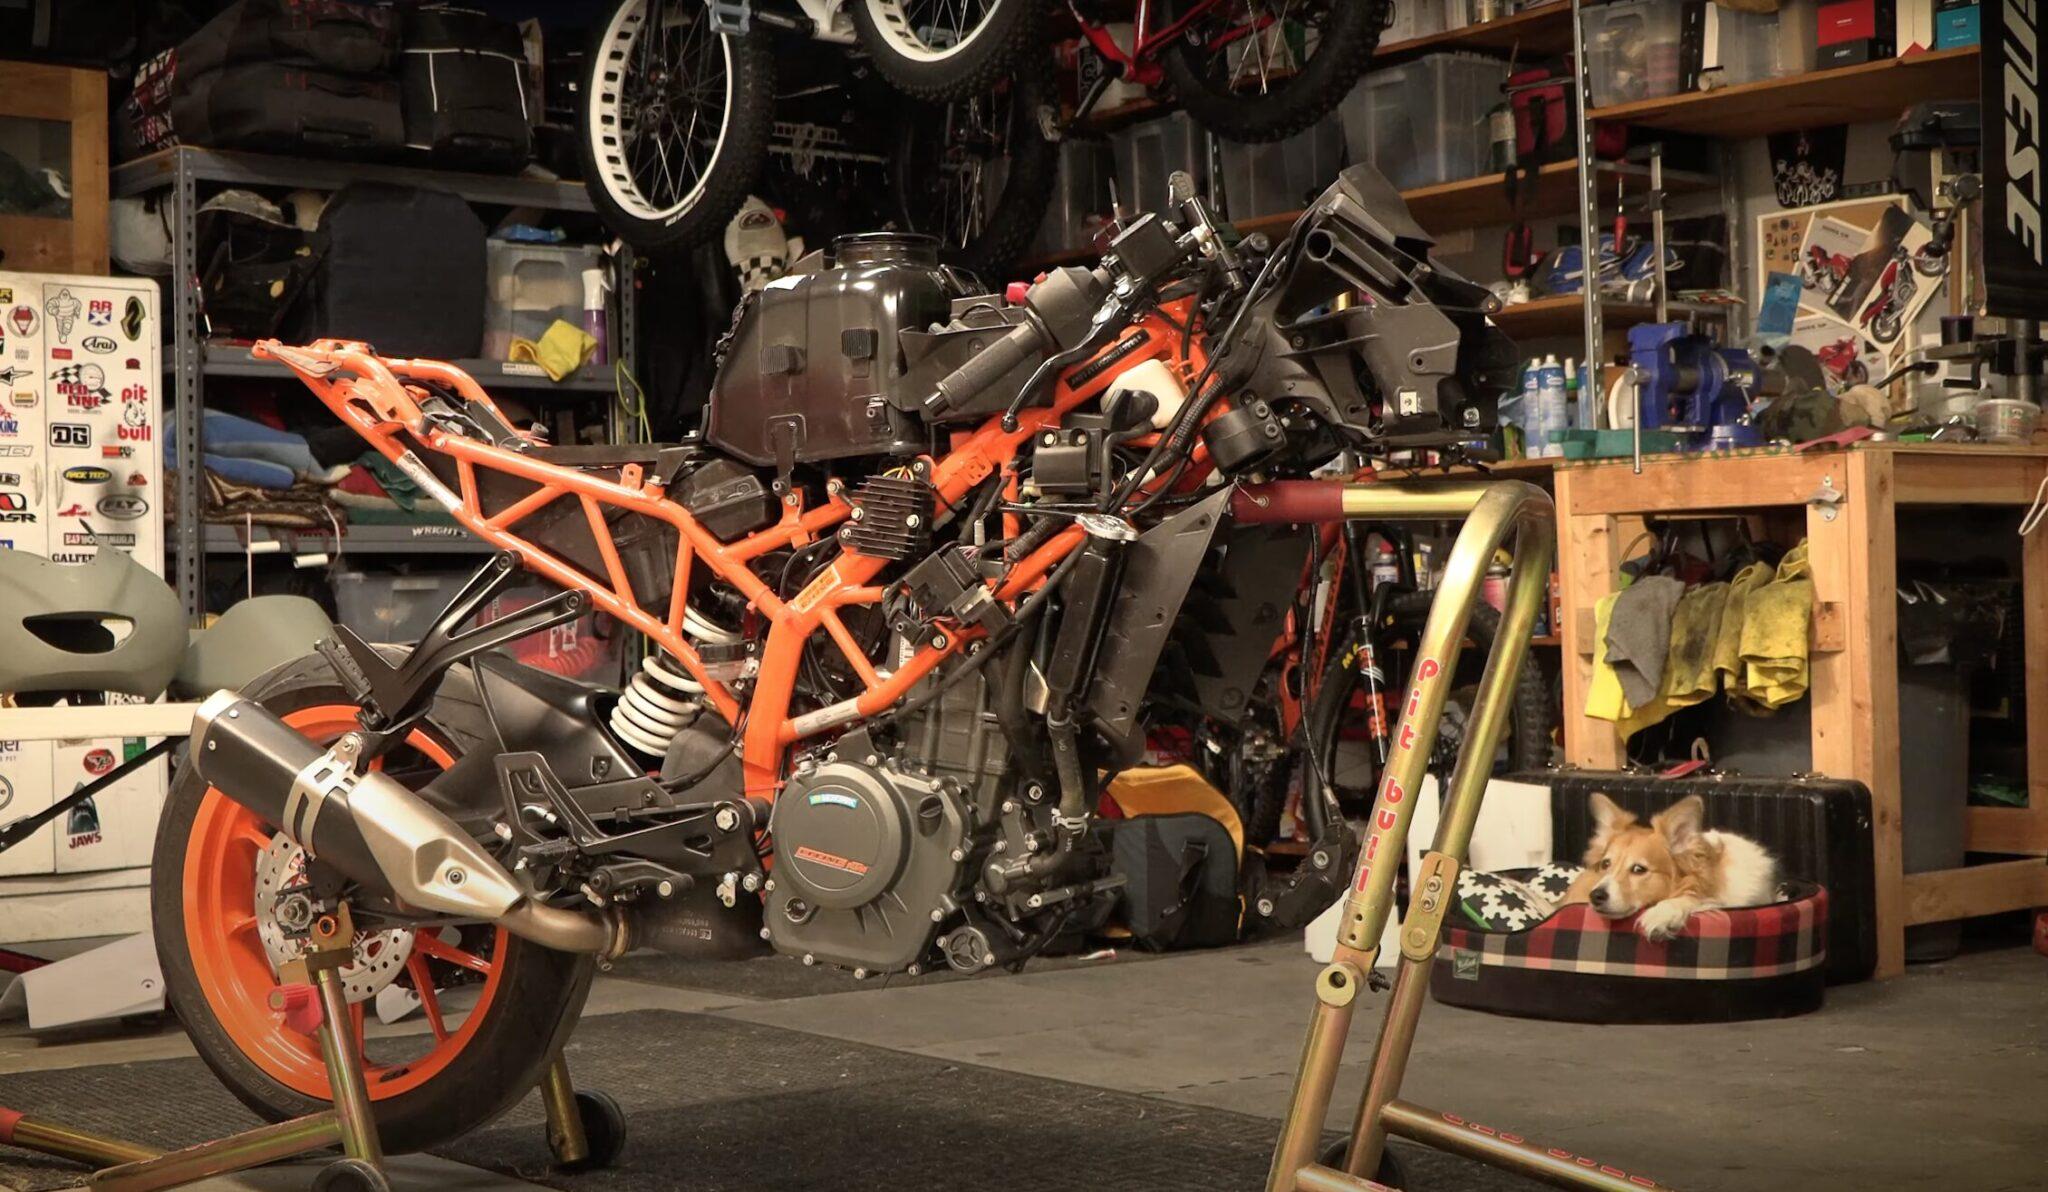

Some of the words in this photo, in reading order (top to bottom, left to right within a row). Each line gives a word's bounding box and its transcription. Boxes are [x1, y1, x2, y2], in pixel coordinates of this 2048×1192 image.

[91, 336, 113, 349] Arai
[121, 384, 148, 404] pit
[52, 426, 88, 445] DG
[117, 424, 151, 442] bull
[1393, 657, 1440, 751] pit
[69, 831, 103, 850] JAWS
[1355, 777, 1404, 894] bull
